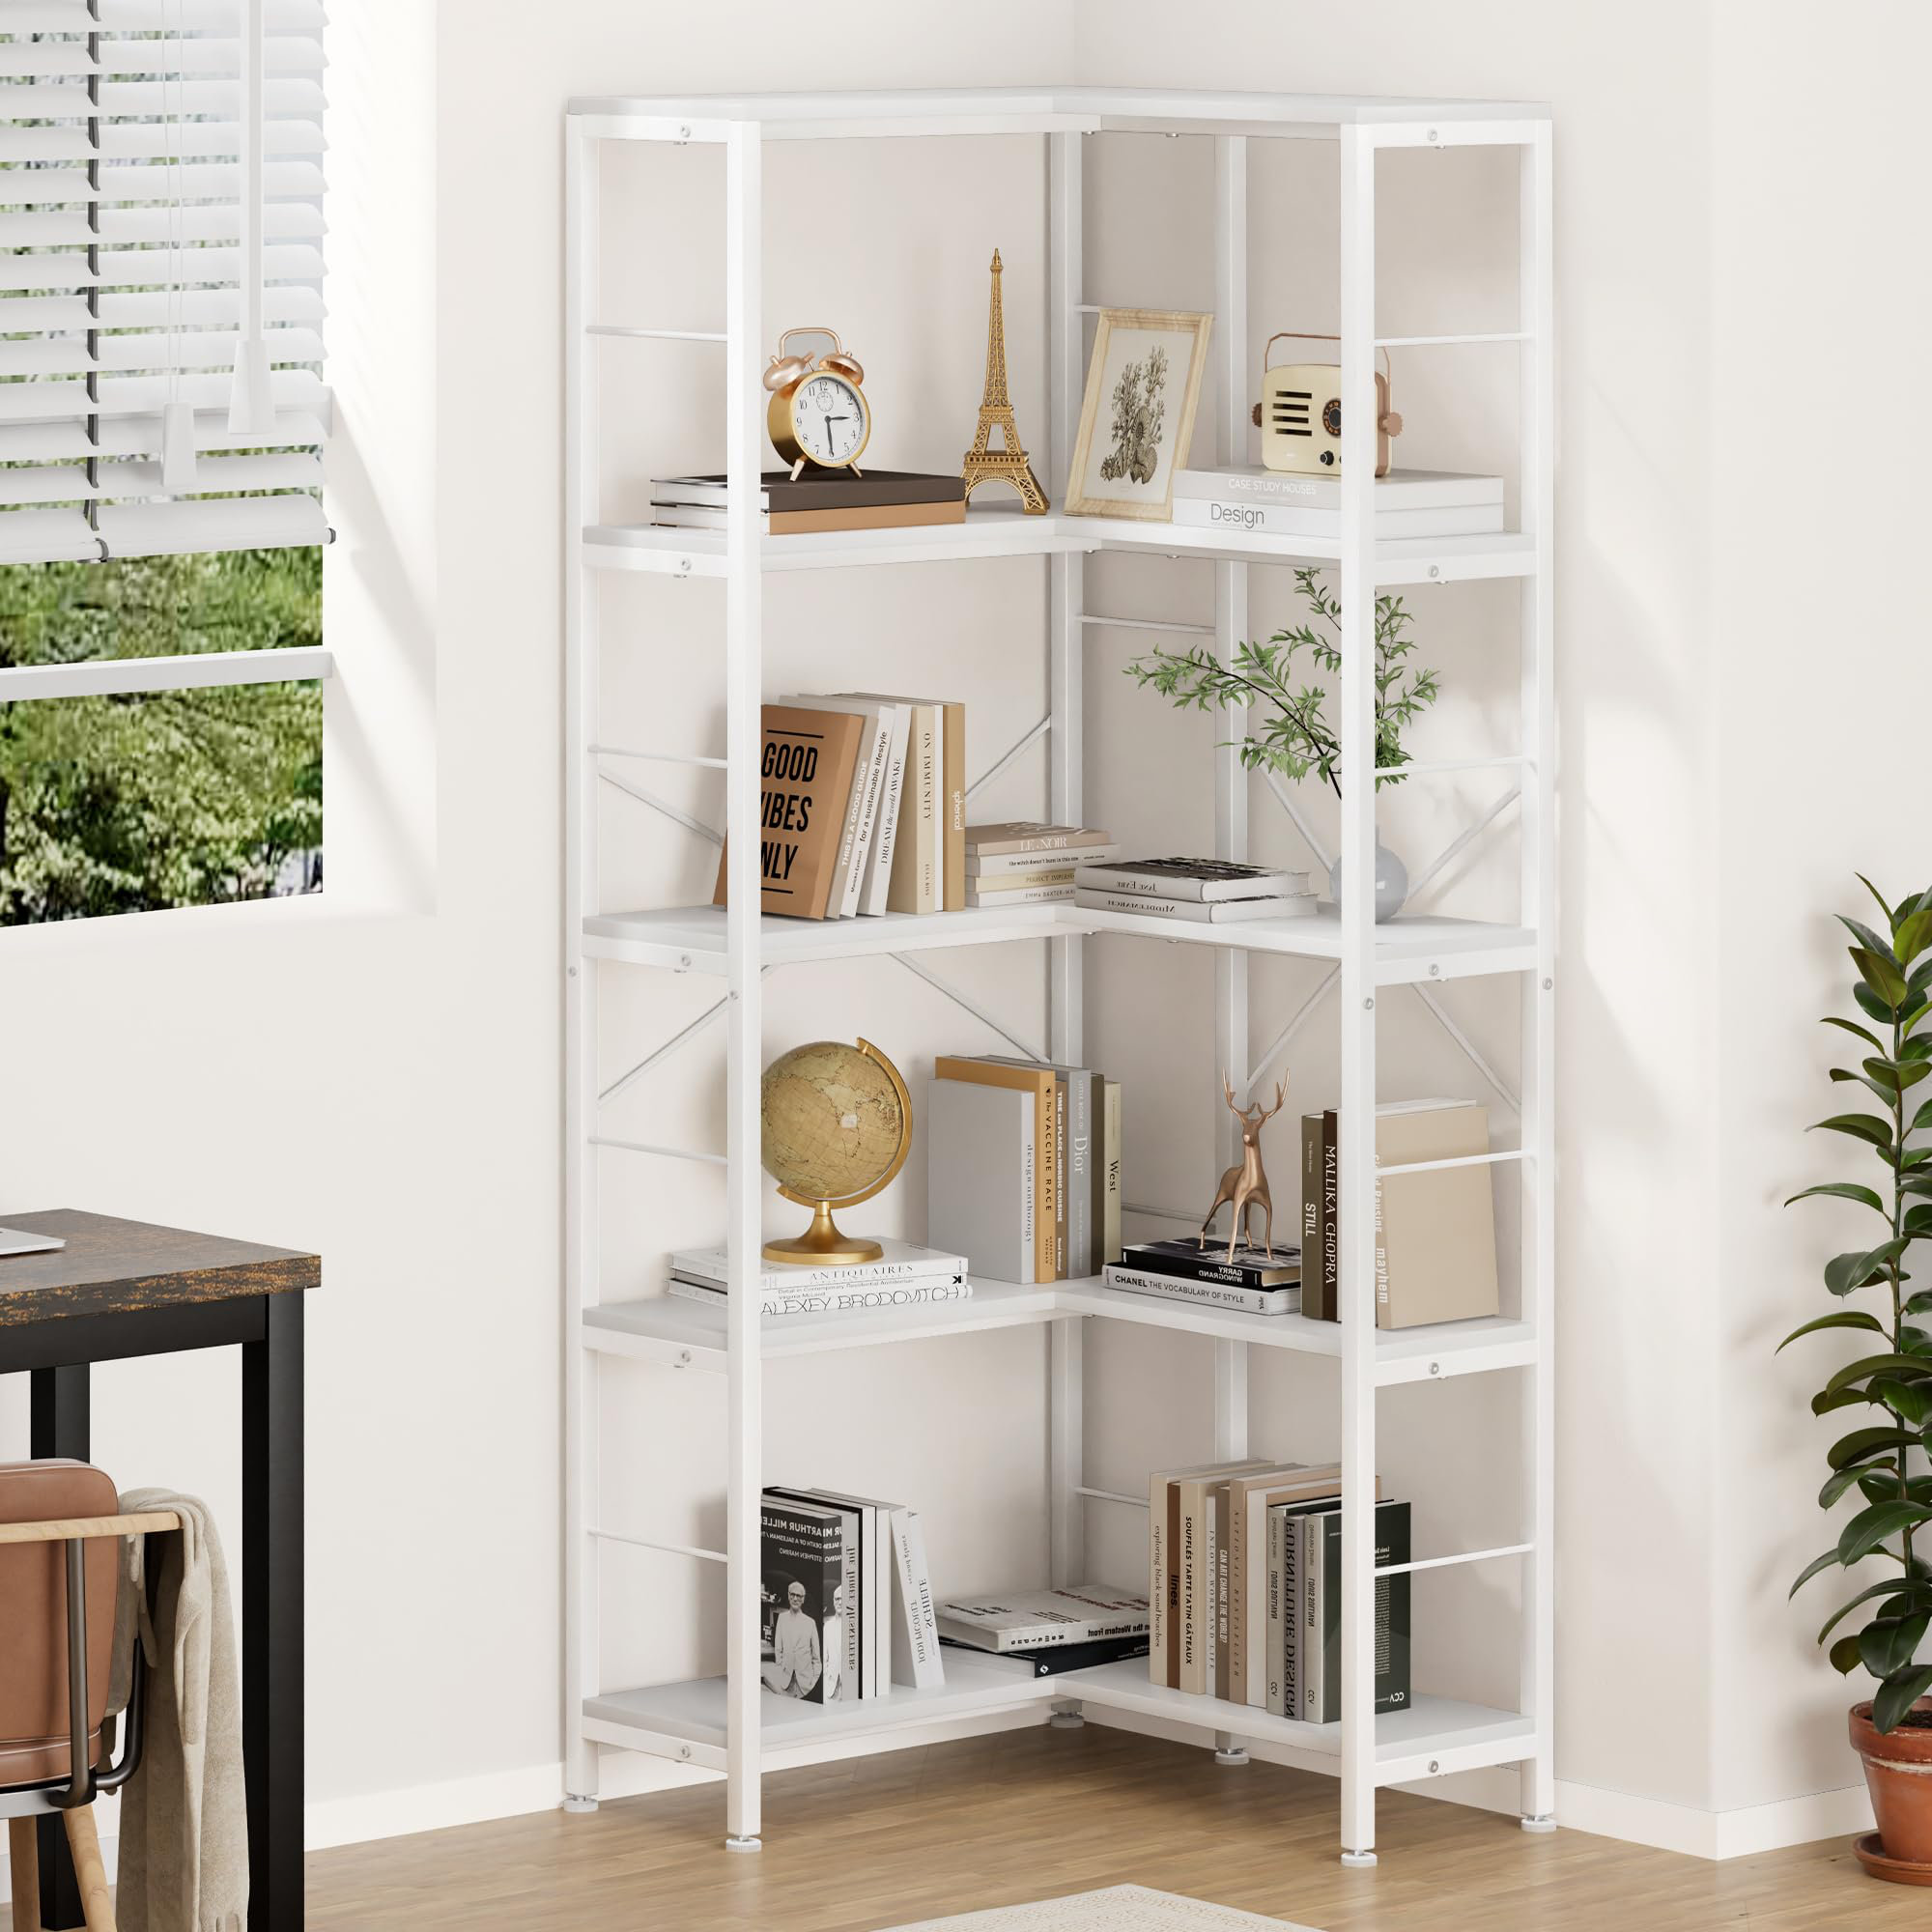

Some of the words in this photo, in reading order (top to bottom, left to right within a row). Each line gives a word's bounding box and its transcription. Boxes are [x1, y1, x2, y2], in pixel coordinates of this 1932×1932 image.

[1228, 478, 1251, 490] CASE
[1253, 480, 1281, 493] STUDY
[1282, 482, 1317, 496] HOUSES
[1210, 503, 1264, 529] Design
[923, 732, 930, 749] ON
[761, 742, 818, 782] GOOD
[859, 829, 867, 842] for
[865, 768, 880, 819] sustainable
[875, 731, 887, 766] lifestyle
[761, 791, 812, 833] IBES
[881, 827, 892, 864] DREAM
[891, 758, 900, 791] AWAKE
[952, 790, 964, 830] spherical
[842, 843, 851, 867] THIS
[851, 793, 861, 823] GOOD
[1040, 837, 1067, 849] NOIR
[761, 841, 799, 881] NLY
[1025, 1144, 1034, 1182] design
[1074, 1136, 1087, 1175] Dior
[1109, 1160, 1120, 1192] West
[1325, 1146, 1336, 1213] MALLIKA
[1305, 1203, 1317, 1236] STILL
[1325, 1222, 1336, 1284] CHOPRA
[811, 1265, 913, 1280] ANTIQUAIRES
[1115, 1275, 1148, 1288] CHANEL
[1149, 1281, 1162, 1290] THE
[1163, 1283, 1210, 1298] VOCABULARY
[1223, 1293, 1245, 1304] STYLE
[1376, 1247, 1389, 1303] mayhem
[761, 1297, 831, 1316] ALEXEY
[838, 1286, 959, 1310] BRODOVITCH
[1170, 1575, 1179, 1609] lines.
[1219, 1604, 1228, 1616] THE
[1219, 1617, 1228, 1643] WORLD?
